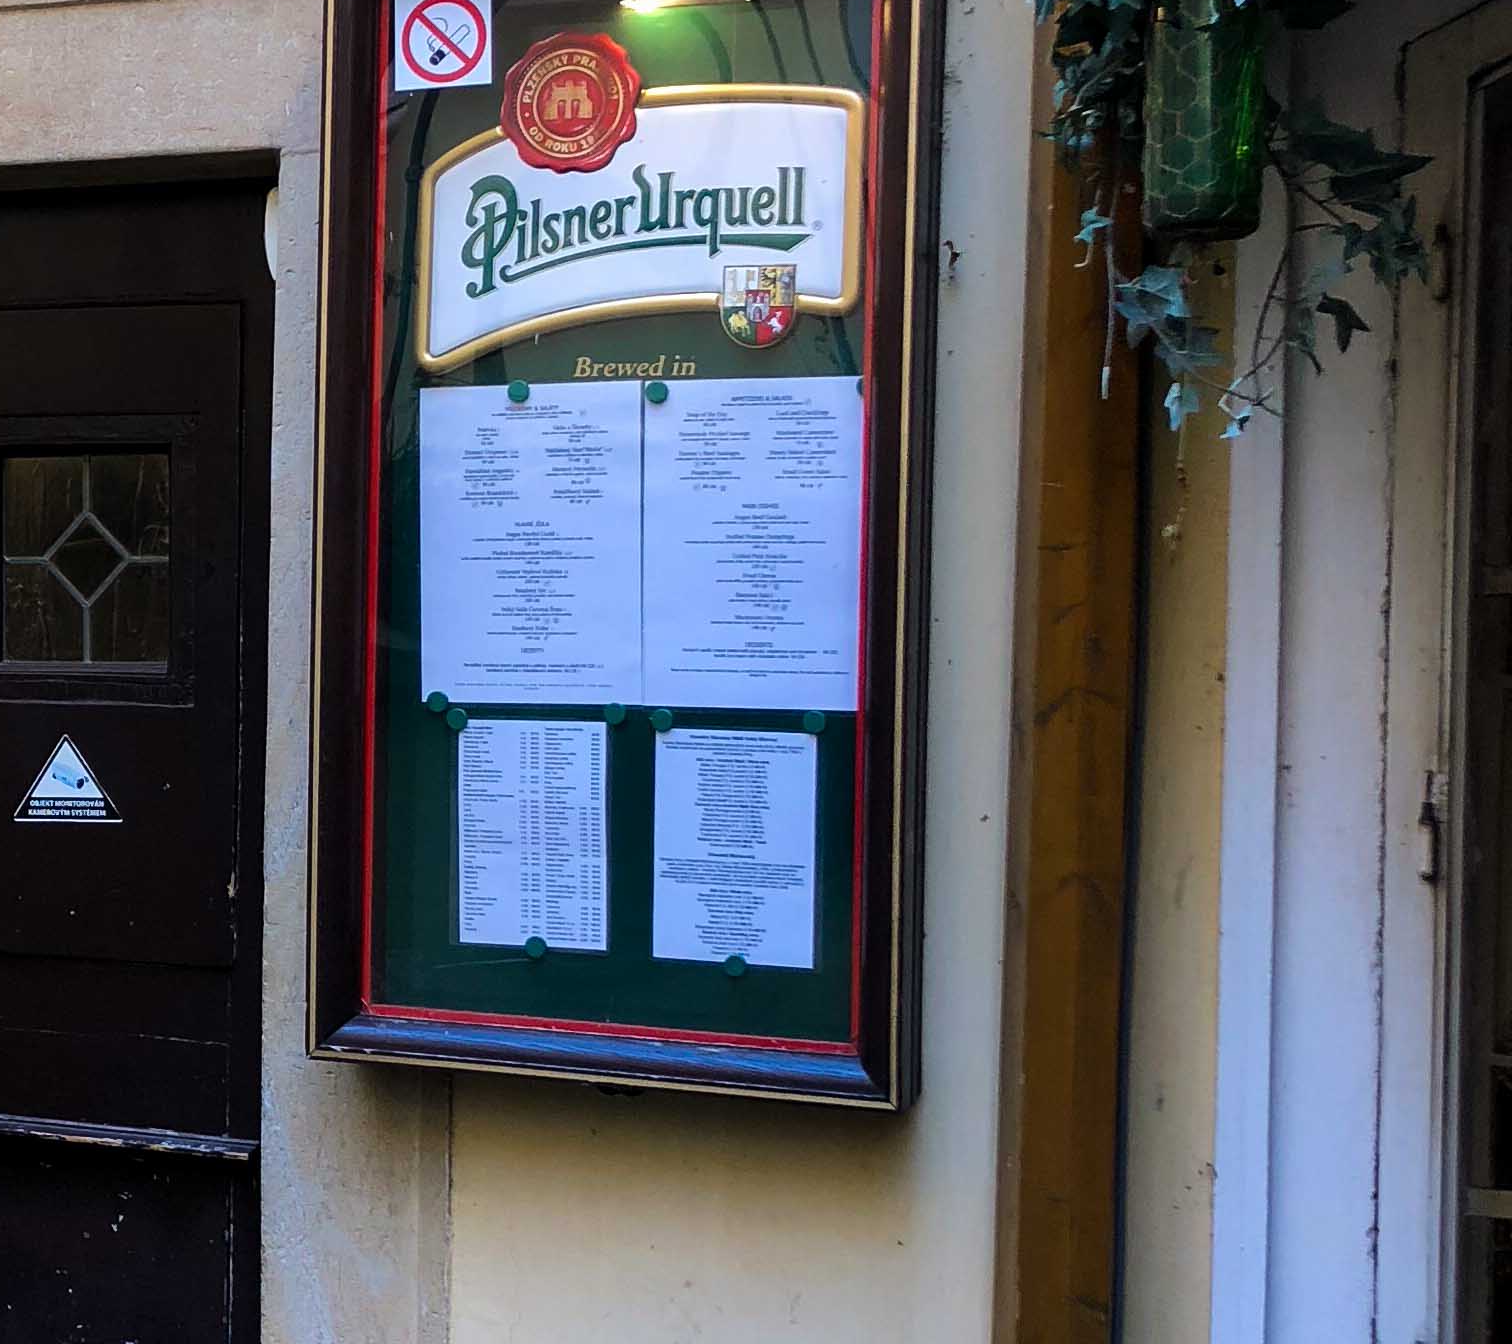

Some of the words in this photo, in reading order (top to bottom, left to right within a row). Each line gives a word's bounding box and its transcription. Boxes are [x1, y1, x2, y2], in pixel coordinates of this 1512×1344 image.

[460, 173, 638, 300] Pilsner
[633, 163, 806, 258] Urquell
[572, 355, 665, 378] Brewed
[670, 353, 697, 376] in
